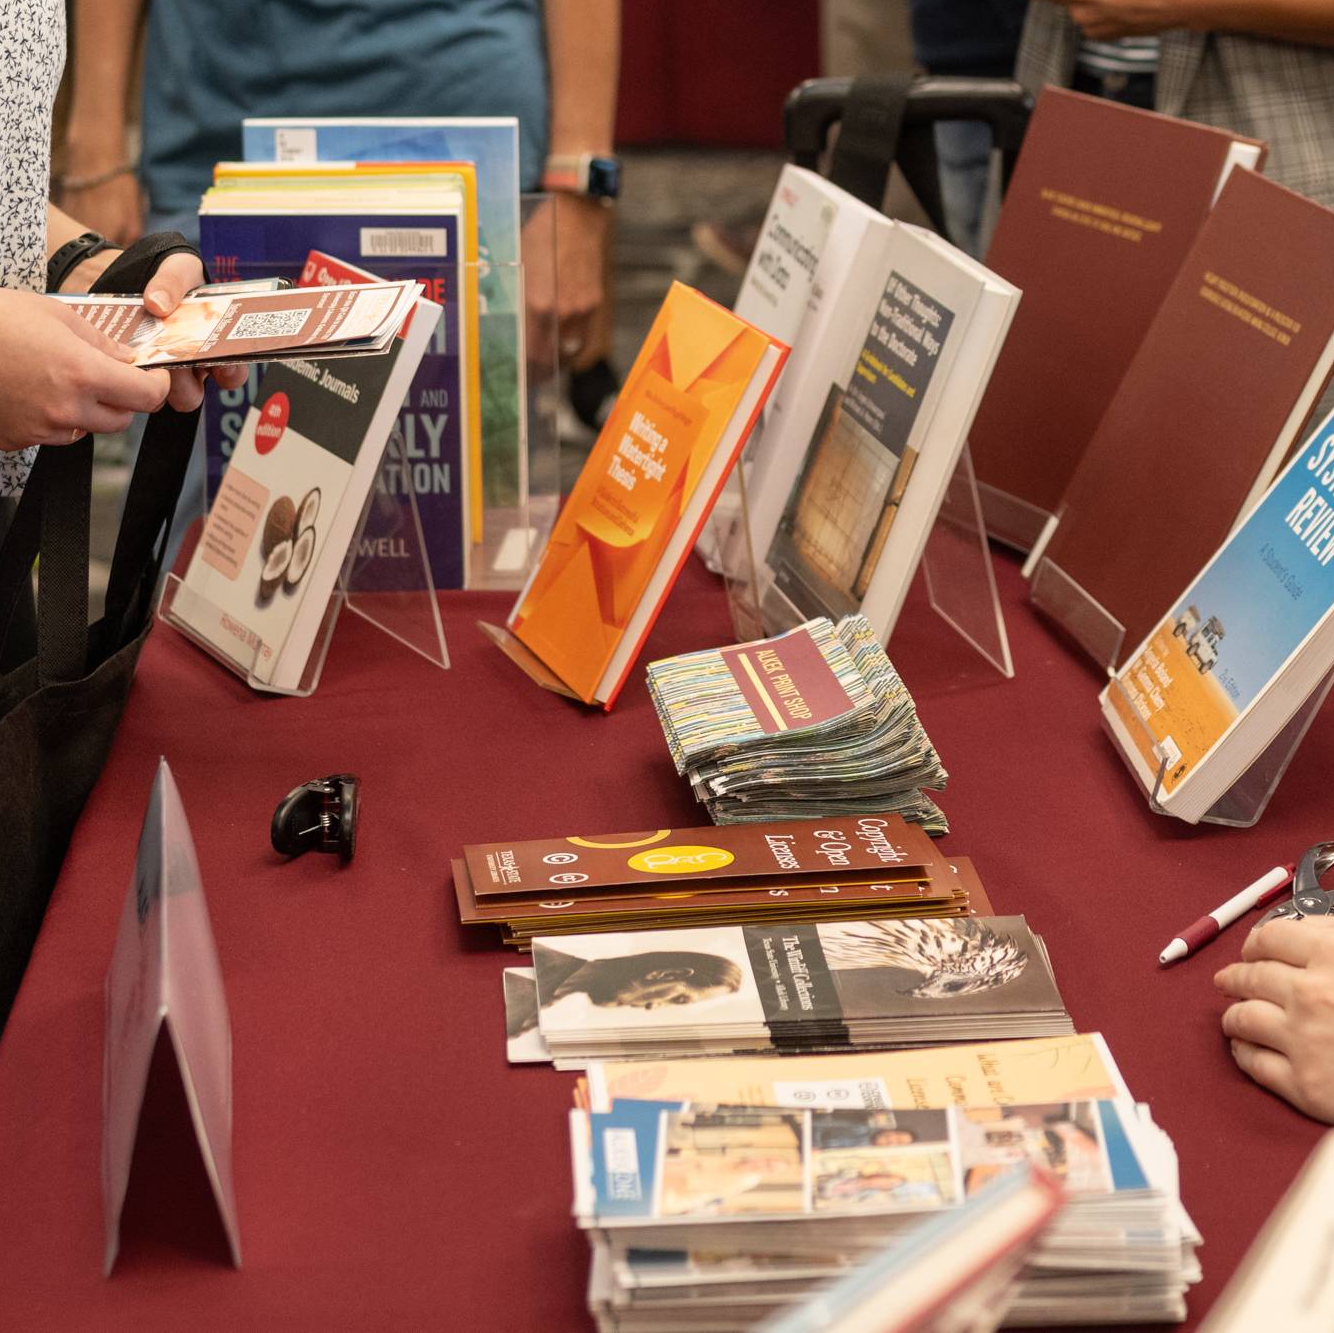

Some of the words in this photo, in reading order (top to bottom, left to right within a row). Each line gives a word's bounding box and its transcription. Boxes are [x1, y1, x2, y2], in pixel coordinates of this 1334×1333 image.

[894, 282, 914, 306] Other
[879, 298, 926, 344] Non-Traditional
[922, 329, 940, 356] Ways
[877, 325, 891, 346] the
[887, 332, 917, 367] Doctorate
[318, 370, 361, 404] Journals
[420, 389, 448, 408] AND
[268, 403, 282, 419] 4th
[255, 424, 283, 439] edition
[628, 410, 664, 453] Writing
[658, 437, 668, 454] a
[618, 432, 667, 484] Watertight
[607, 453, 638, 491] Thesis
[755, 649, 786, 675] ALKEK
[770, 674, 800, 700] PRINT
[784, 696, 813, 720] SHOP
[813, 829, 844, 841] &
[856, 817, 908, 864] Copyright
[500, 850, 516, 870] TEXAS
[764, 833, 801, 870] Licenses
[816, 840, 853, 867] Open
[782, 935, 800, 951] The
[793, 973, 816, 1011] Collections
[976, 1053, 1000, 1077] What
